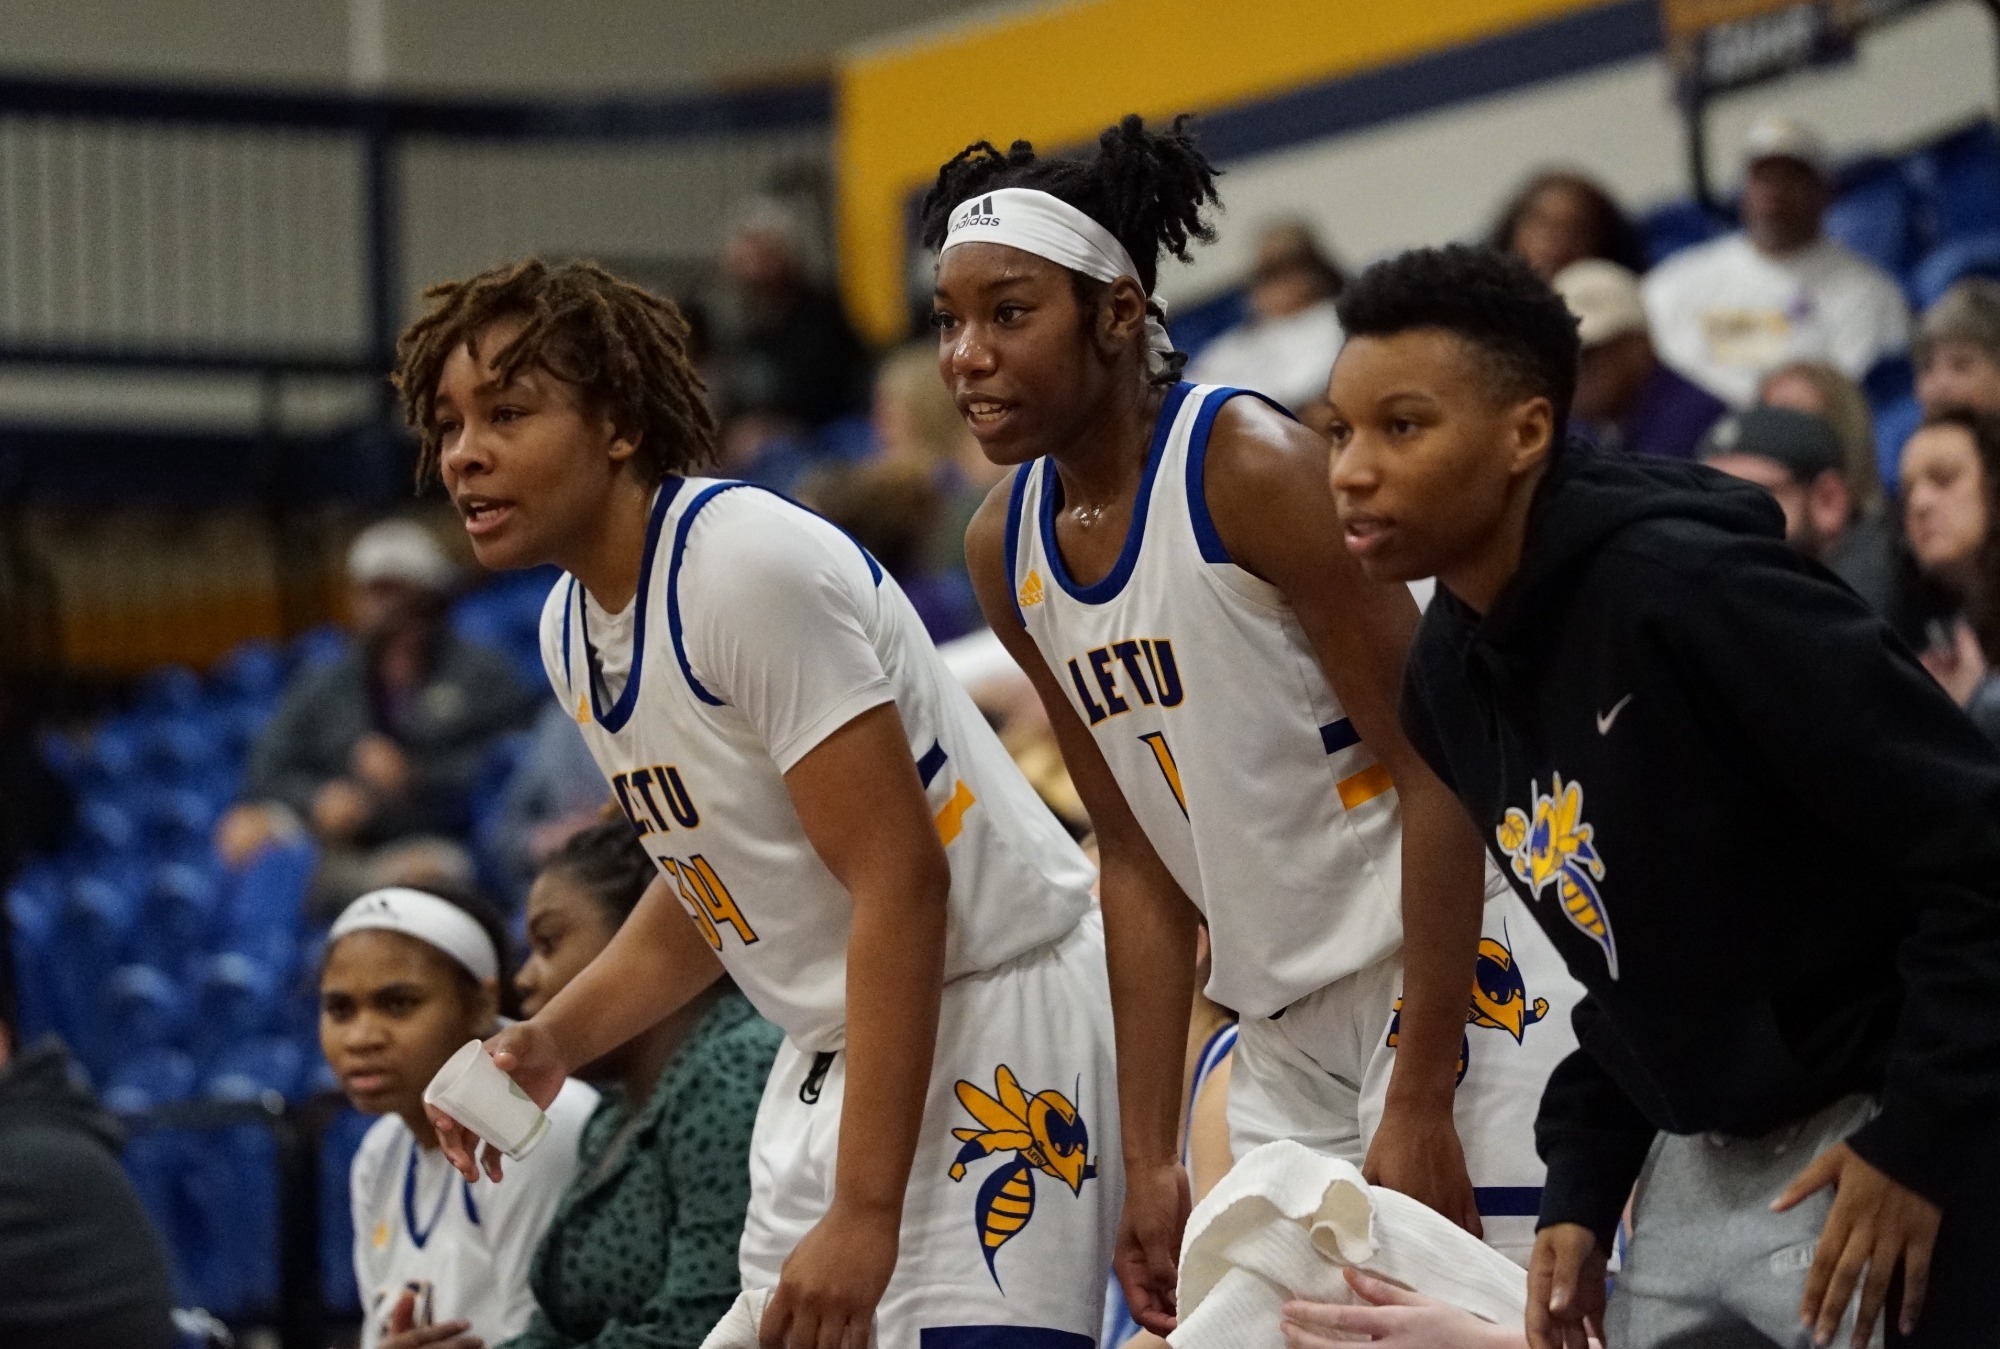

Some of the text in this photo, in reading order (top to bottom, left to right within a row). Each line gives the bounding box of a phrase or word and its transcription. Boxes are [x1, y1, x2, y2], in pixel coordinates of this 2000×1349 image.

[952, 214, 1001, 233] adidas
[1067, 638, 1185, 726] LETU
[611, 765, 700, 838] ETU
[1137, 731, 1191, 824] 1
